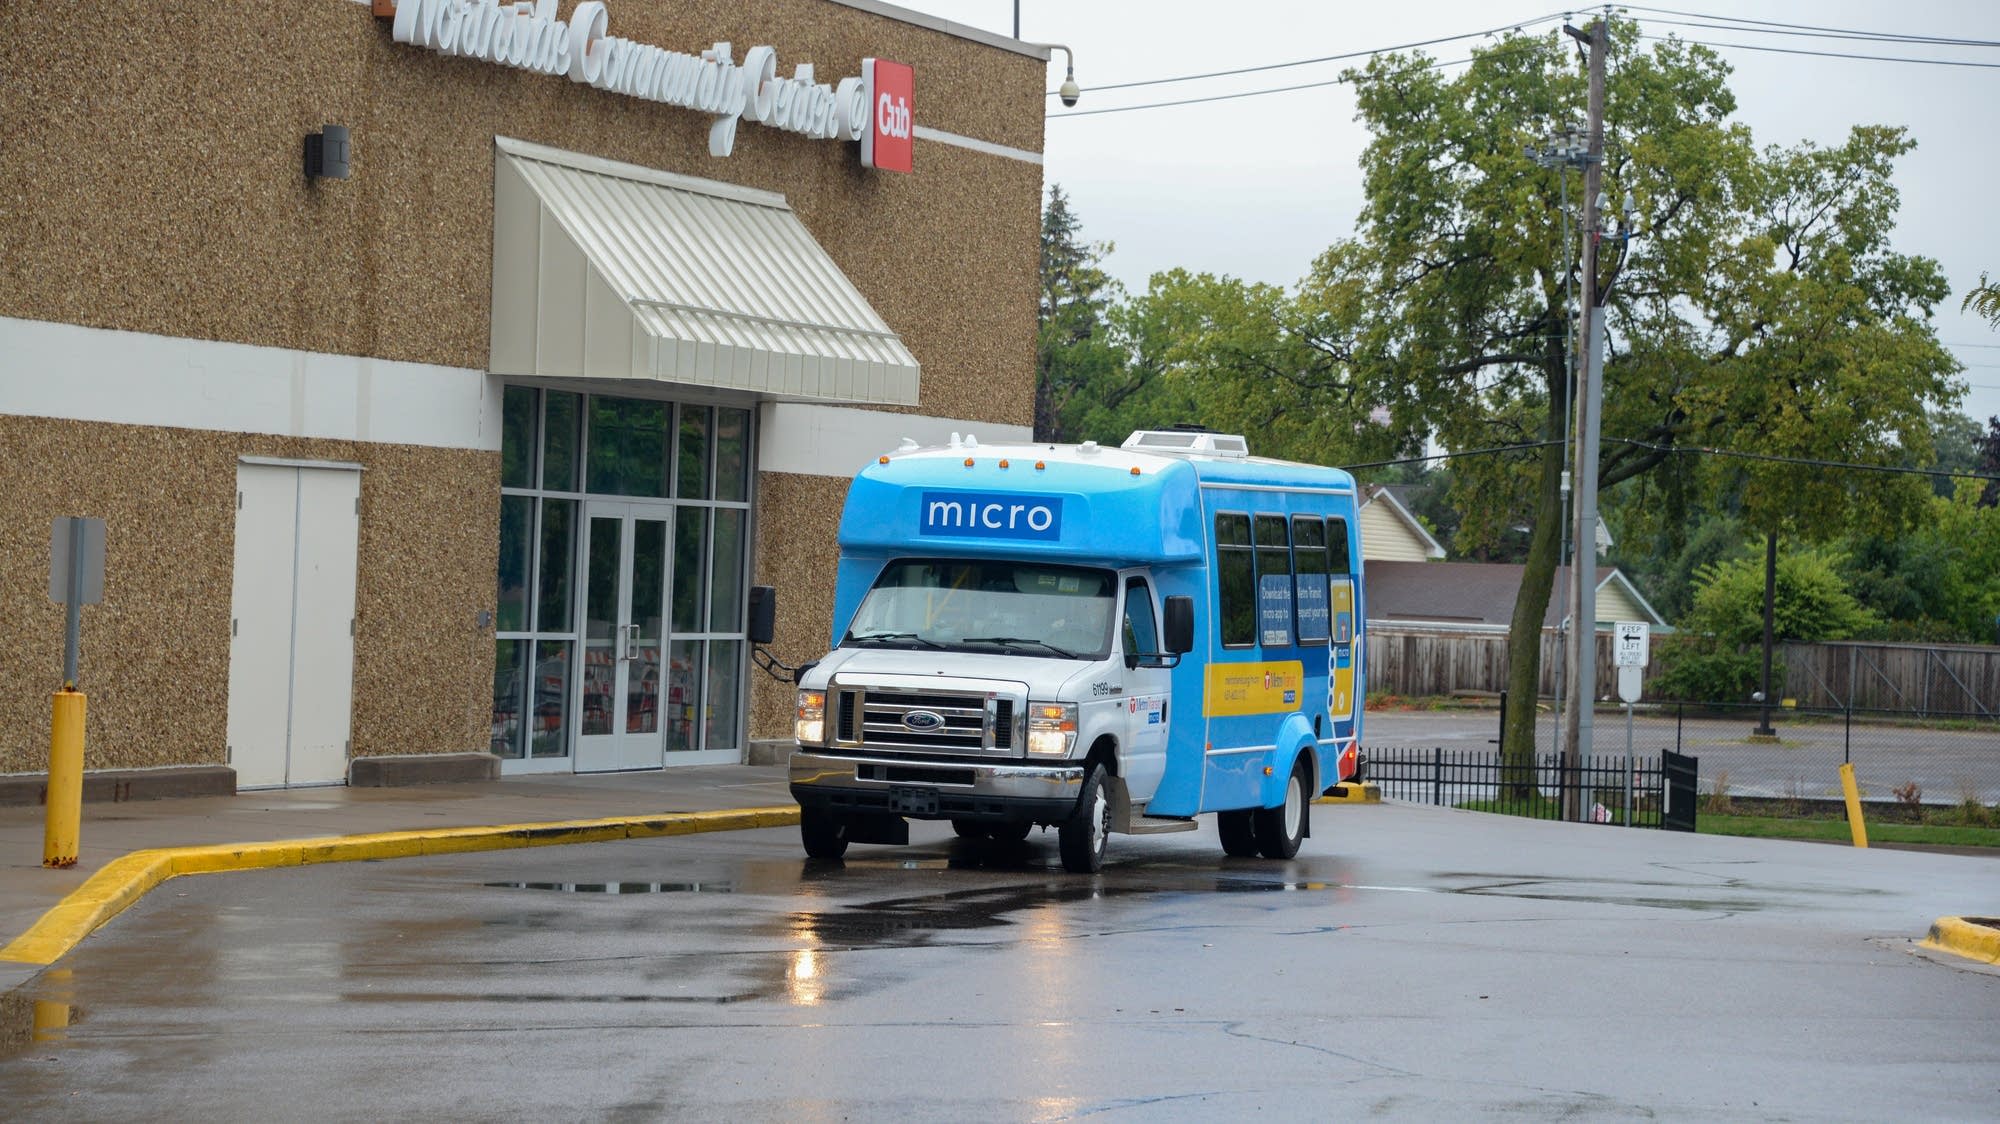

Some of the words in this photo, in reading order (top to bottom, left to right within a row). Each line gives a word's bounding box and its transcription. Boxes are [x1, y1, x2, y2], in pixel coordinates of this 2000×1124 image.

[568, 2, 746, 156] Community
[879, 92, 910, 140] Cub
[928, 501, 1053, 531] micro
[1298, 609, 1312, 621] equest
[1622, 625, 1642, 633] KEEP
[1622, 642, 1640, 650] LEFT
[1093, 682, 1108, 696] 61199
